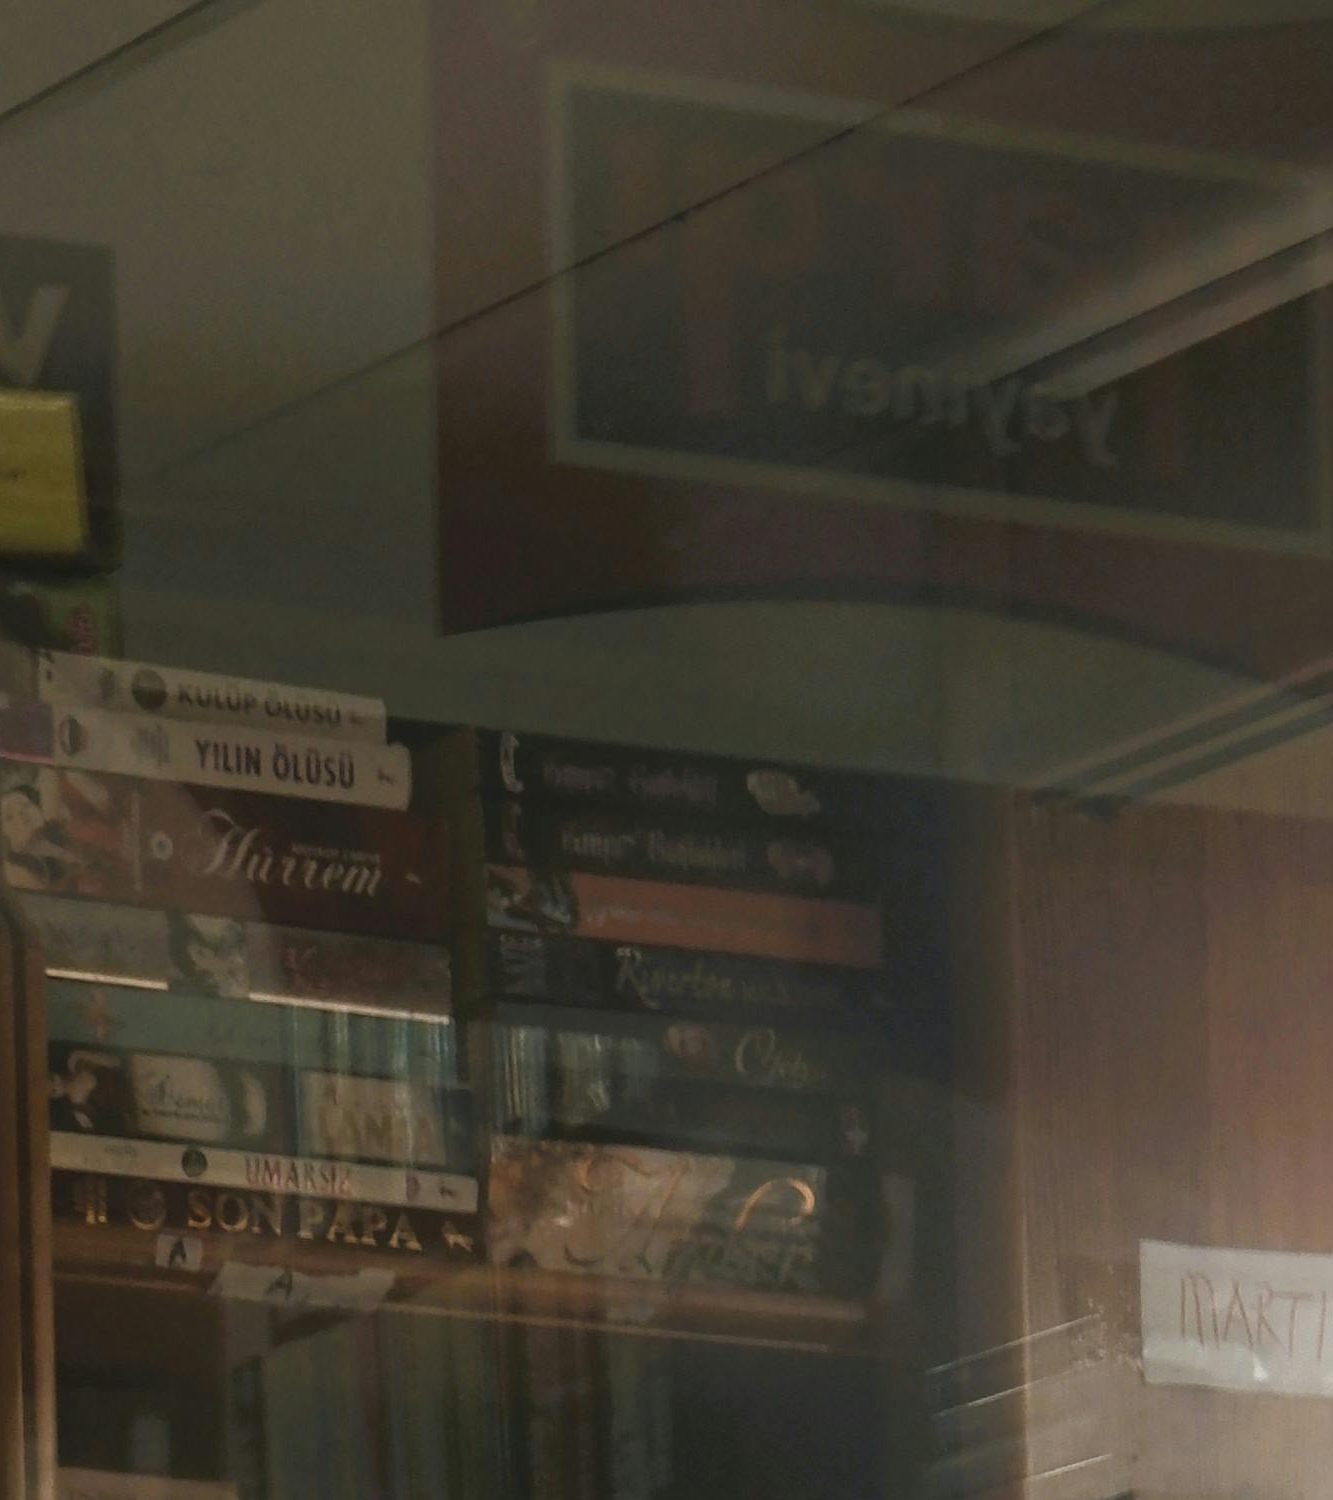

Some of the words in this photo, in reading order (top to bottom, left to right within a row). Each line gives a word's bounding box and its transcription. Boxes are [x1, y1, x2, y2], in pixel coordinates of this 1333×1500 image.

[195, 738, 263, 778] YILIN
[272, 743, 355, 790] ÖLÜSÜ
[201, 808, 385, 898] Hürrem
[188, 1190, 285, 1237] SON
[296, 1204, 421, 1254] PAPA
